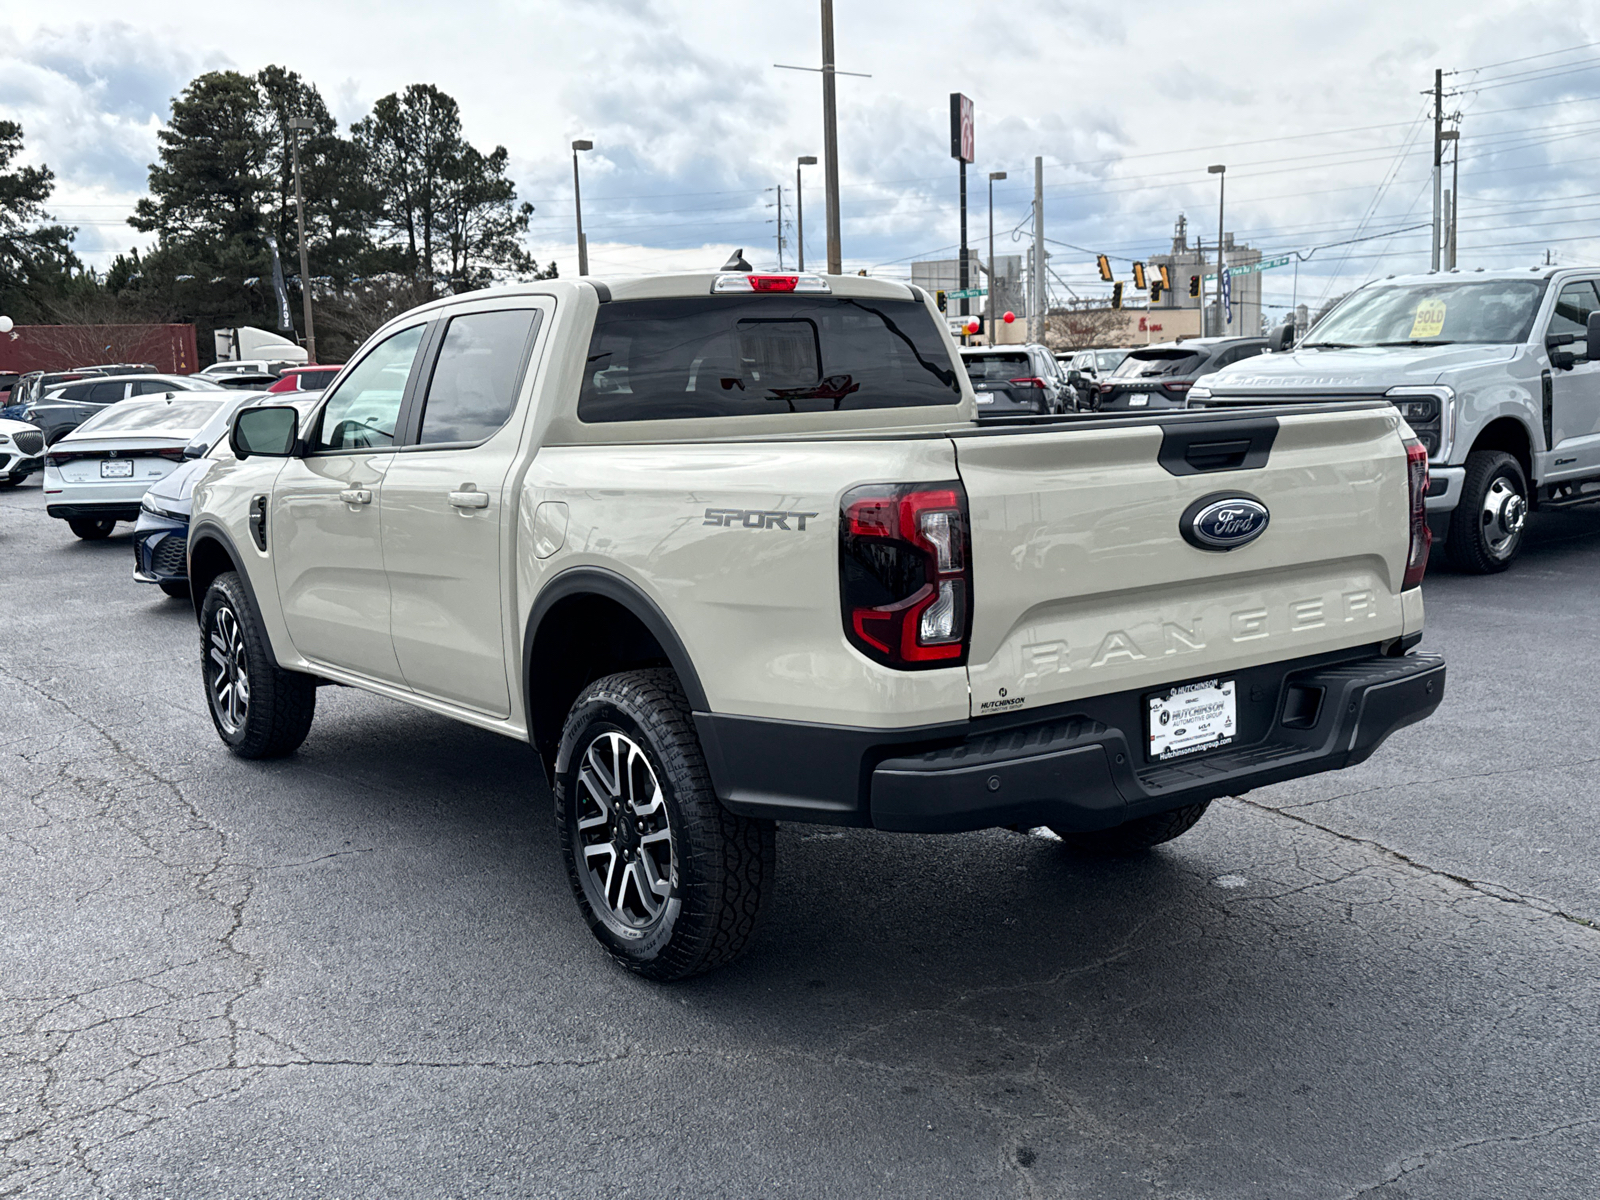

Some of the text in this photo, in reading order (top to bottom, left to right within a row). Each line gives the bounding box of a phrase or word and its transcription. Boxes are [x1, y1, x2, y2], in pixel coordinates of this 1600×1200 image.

[1417, 309, 1444, 324] SOLD
[1230, 376, 1364, 386] SUPER DUTY
[702, 508, 819, 532] SPORT
[1214, 509, 1254, 535] Ford
[1020, 589, 1377, 678] RANGER
[1178, 679, 1219, 694] HUTCHINSON
[980, 696, 1026, 709] HUTCHINSON
[1172, 702, 1225, 721] HUTCHINSON
[1172, 711, 1224, 728] AUTOMOTIVE GROUP
[1160, 737, 1232, 760] Hutchinsonautogroup.com
